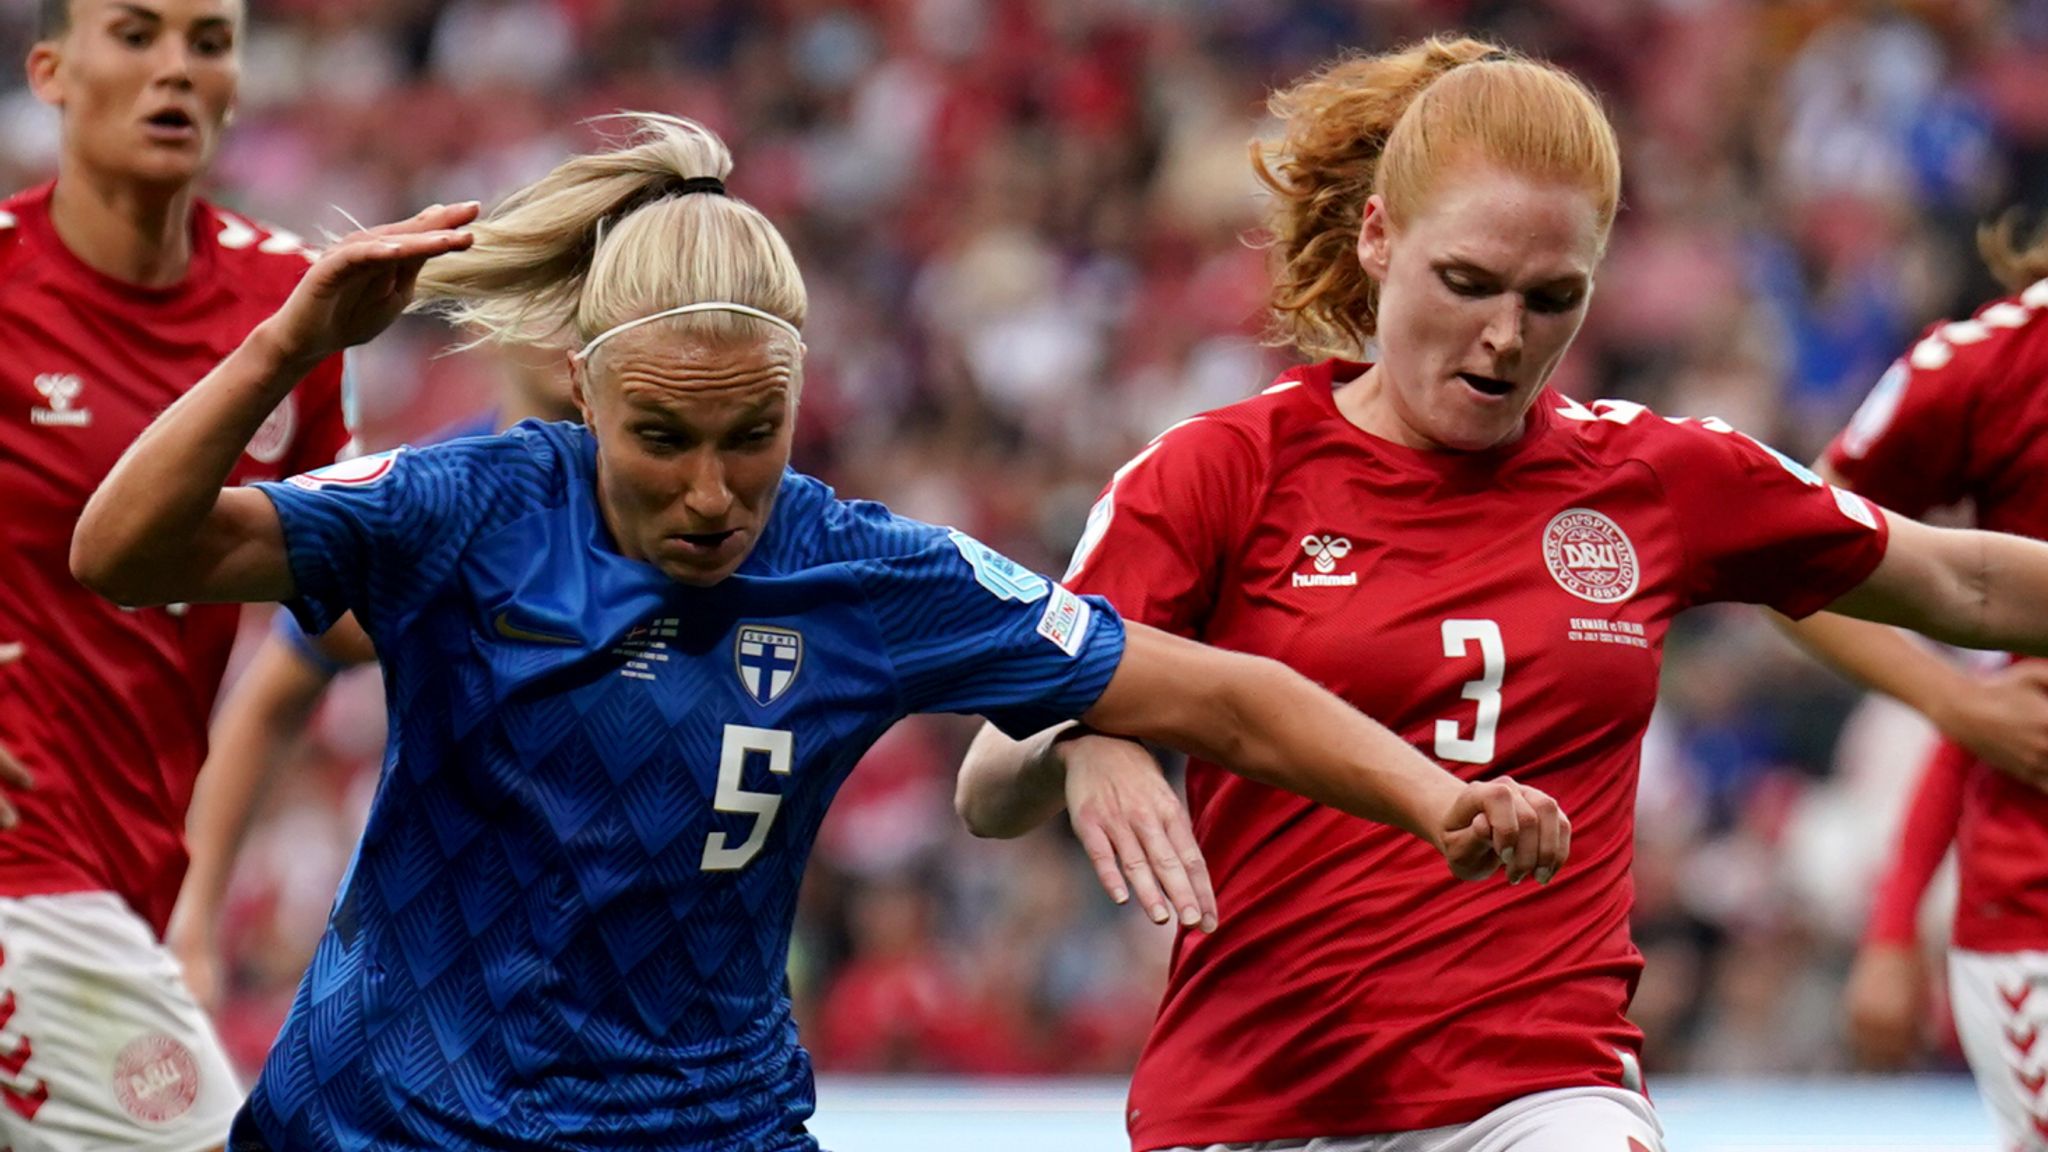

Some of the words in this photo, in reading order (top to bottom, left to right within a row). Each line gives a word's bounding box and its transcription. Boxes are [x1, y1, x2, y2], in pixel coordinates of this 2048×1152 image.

[1547, 538, 1580, 590] DANSK
[1562, 542, 1619, 568] DBU
[1616, 541, 1634, 588] UNION
[1292, 571, 1357, 587] hummel
[1585, 586, 1620, 598] 1889
[747, 631, 793, 645] SUOMI
[1570, 617, 1609, 631] DENMARK
[1616, 621, 1645, 636] FINLAND
[1434, 618, 1506, 764] 3
[700, 723, 792, 870] 5
